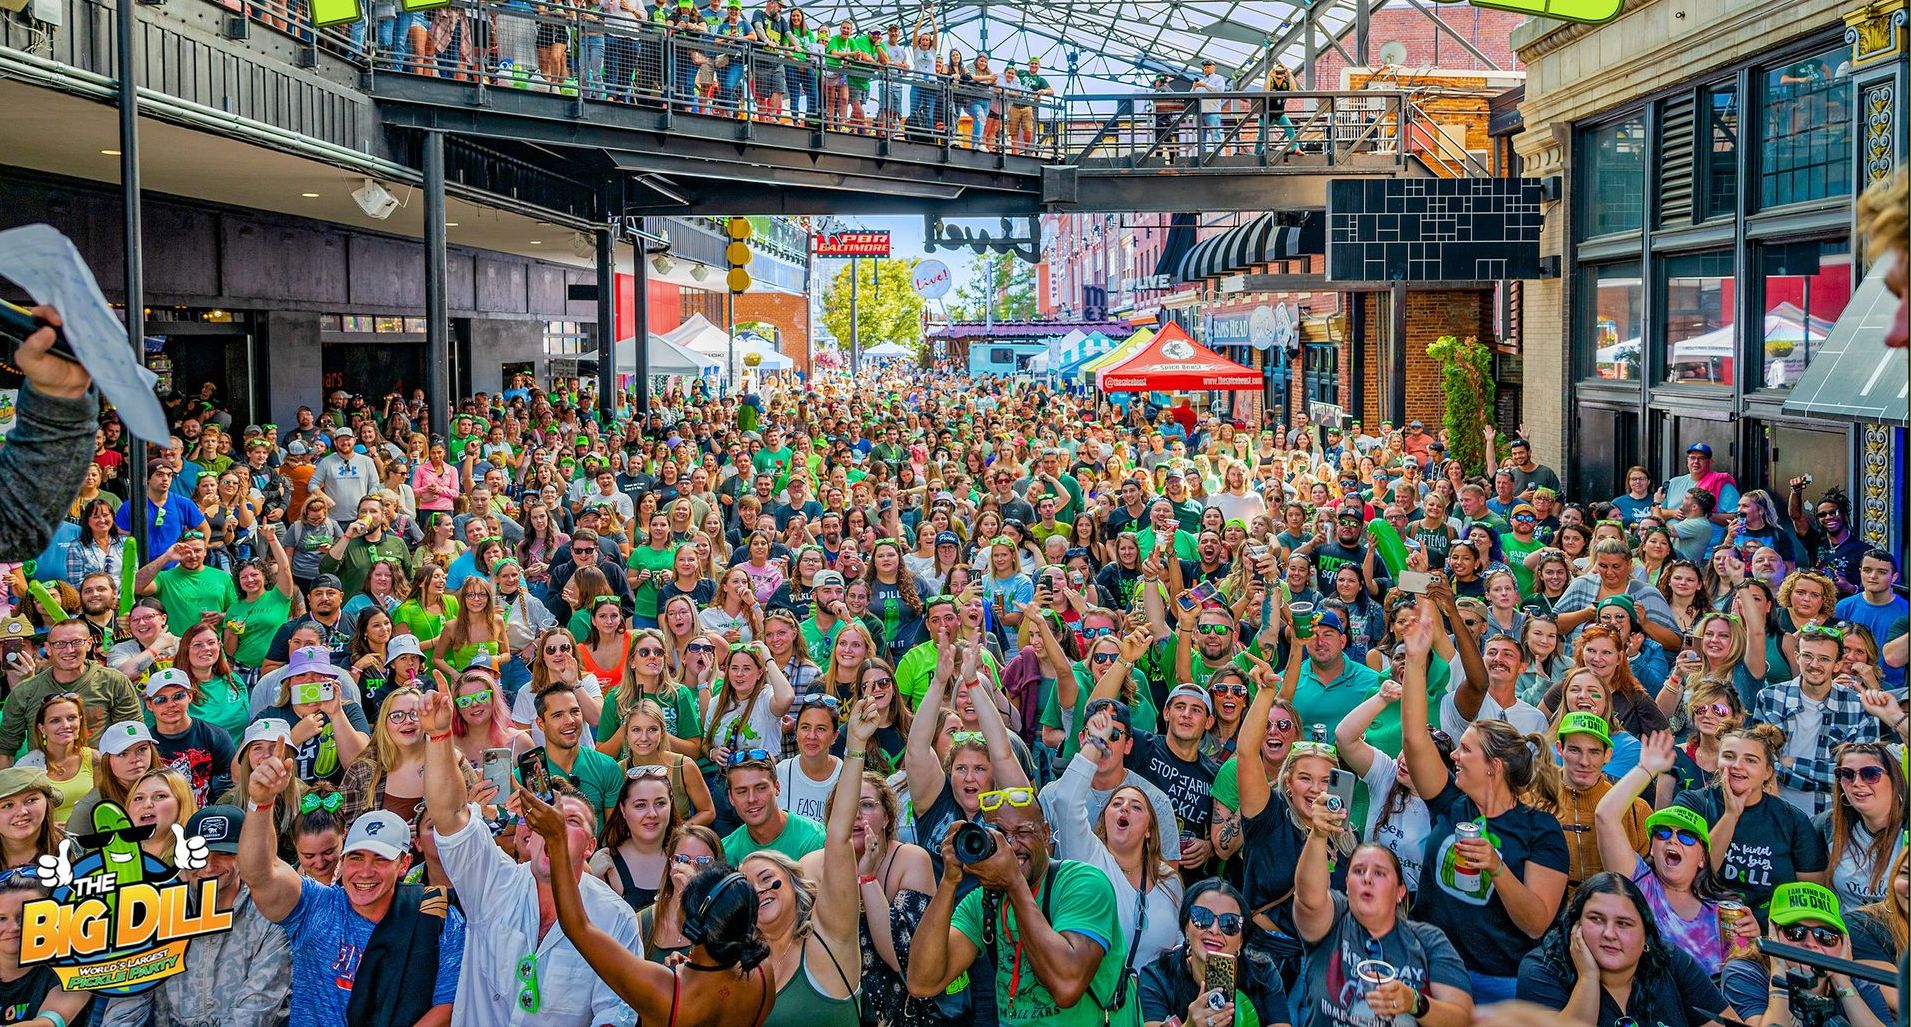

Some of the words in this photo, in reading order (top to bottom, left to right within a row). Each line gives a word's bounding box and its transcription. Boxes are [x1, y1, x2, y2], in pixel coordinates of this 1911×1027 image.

[842, 234, 888, 243] PBR
[818, 243, 888, 252] BALTIMORE
[916, 269, 948, 291] Live!
[1230, 320, 1249, 337] HEAD
[1415, 532, 1447, 548] PRETEND
[1149, 757, 1179, 780] STOP
[1168, 783, 1185, 797] AT
[796, 798, 826, 818] EASIL
[1389, 840, 1400, 851] &
[1742, 844, 1773, 856] kind
[1747, 855, 1773, 870] big
[1801, 888, 1818, 896] KIND
[1789, 895, 1808, 908] BIG
[1011, 1008, 1028, 1019] ALL
[1031, 1006, 1060, 1019] EARS
